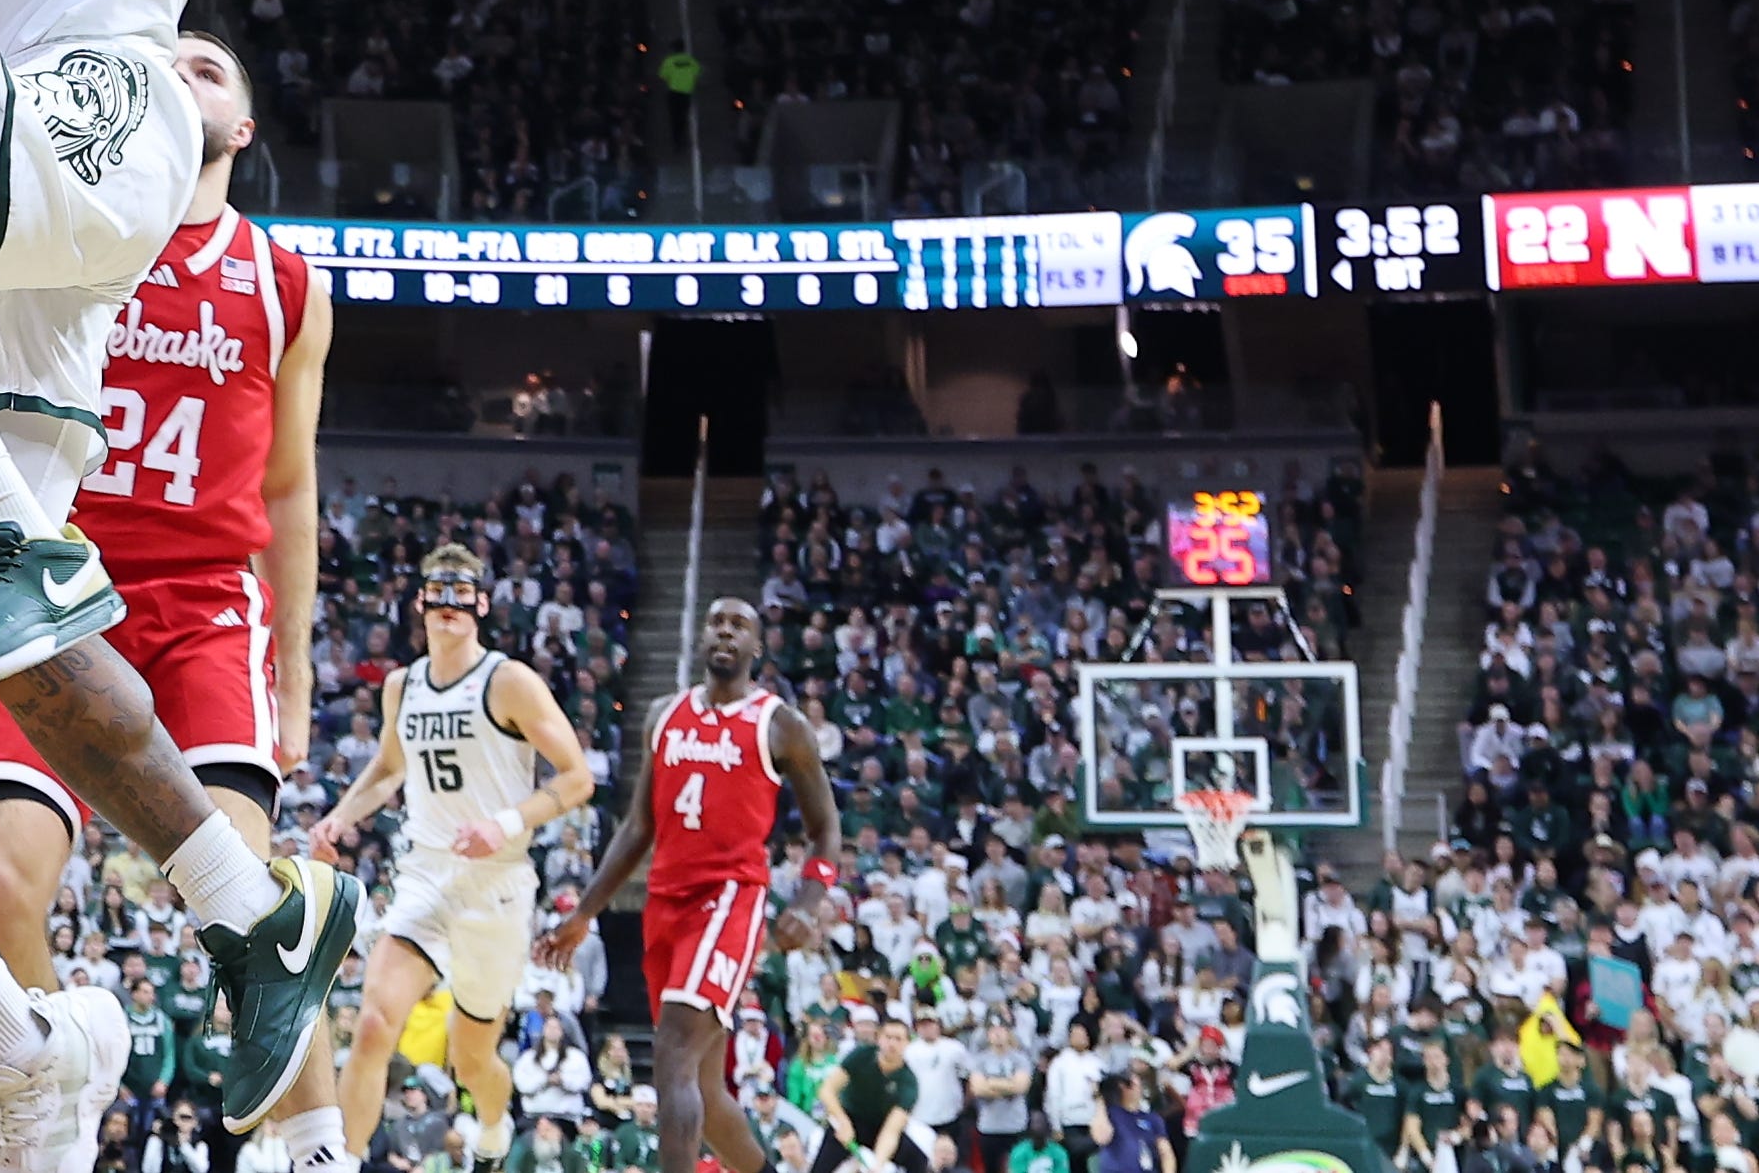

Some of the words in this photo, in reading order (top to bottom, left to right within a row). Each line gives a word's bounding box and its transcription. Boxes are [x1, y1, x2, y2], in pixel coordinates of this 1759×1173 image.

[1214, 215, 1297, 275] 35
[1334, 204, 1461, 258] 3:52
[1505, 203, 1591, 265] 22
[1600, 195, 1694, 280] N
[101, 297, 245, 386] ebraska
[81, 385, 207, 507] 24
[1192, 490, 1263, 527] 3:52
[1183, 526, 1257, 586] 25
[406, 709, 476, 741] STATE
[418, 748, 464, 793] 15
[673, 771, 705, 830] 4
[706, 948, 740, 995] N
